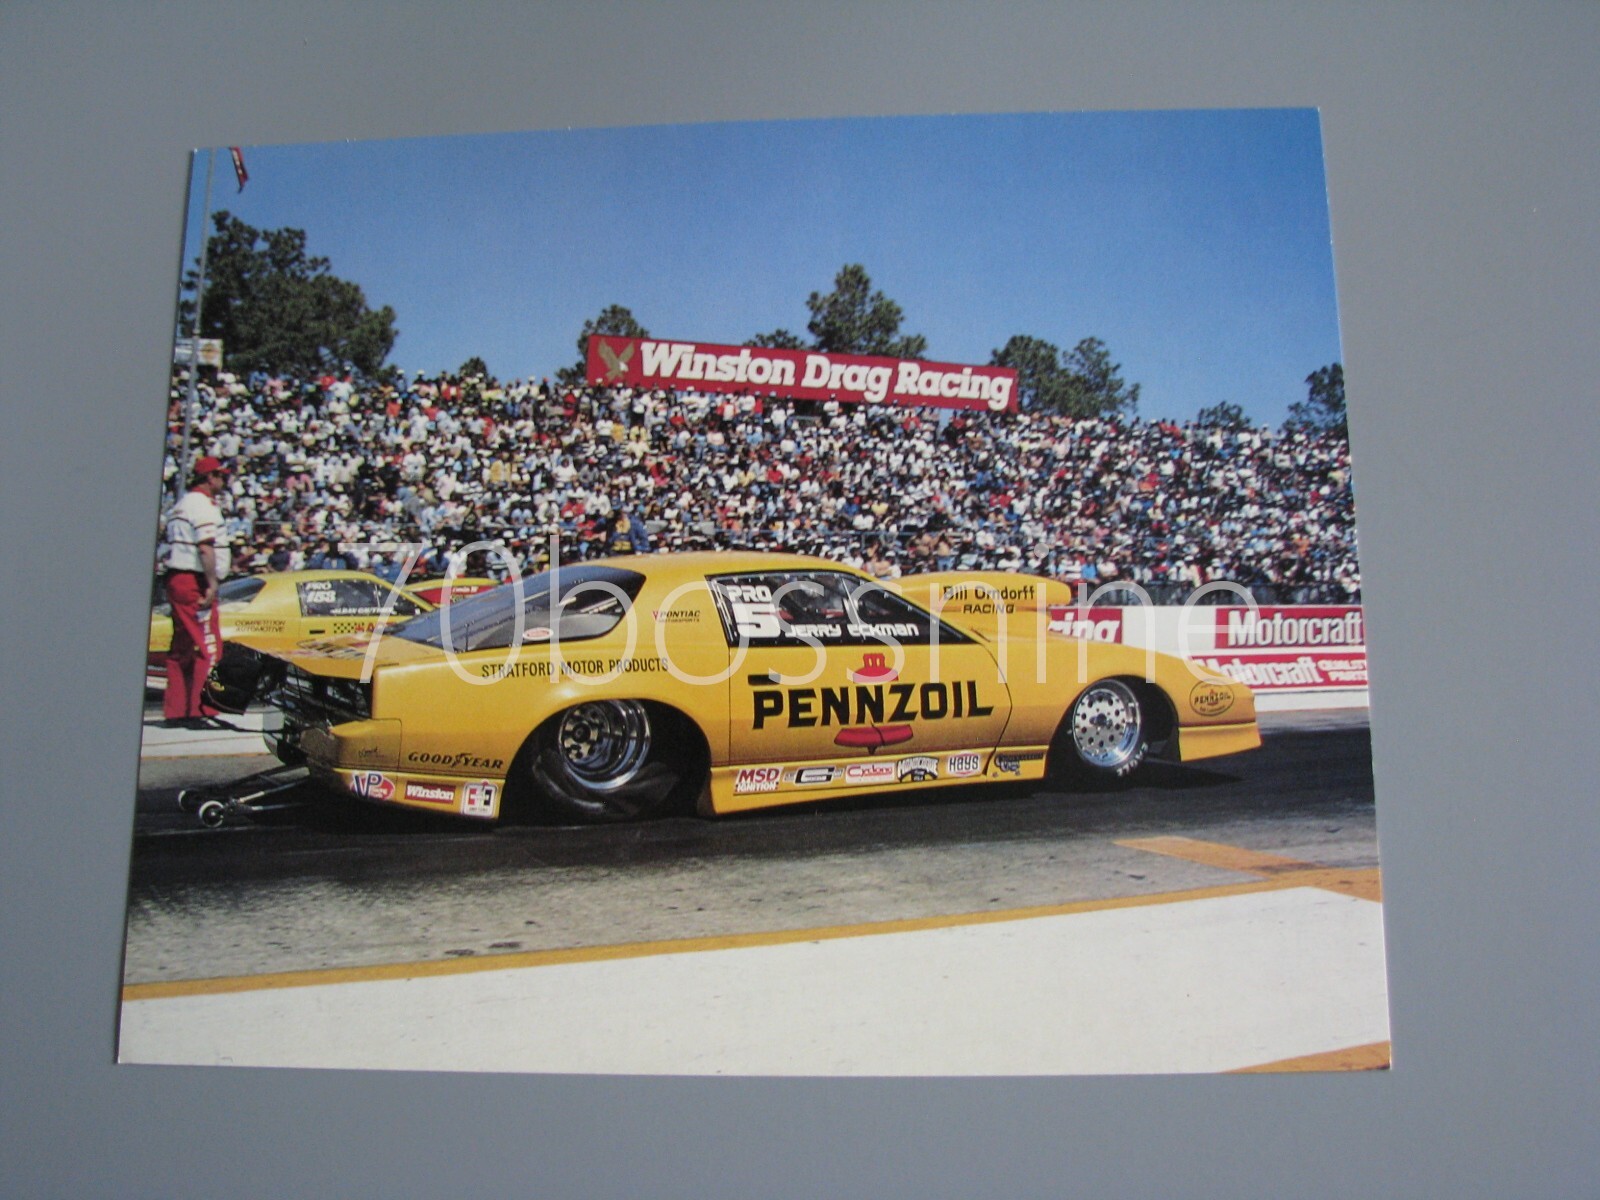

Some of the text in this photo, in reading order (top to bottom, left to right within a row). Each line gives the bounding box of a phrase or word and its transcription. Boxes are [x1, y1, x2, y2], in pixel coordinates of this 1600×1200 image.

[640, 341, 1013, 410] Winston Drag Racing
[727, 585, 773, 602] PRO
[943, 585, 968, 600] Bill
[660, 610, 700, 618] PONTIAC
[962, 603, 1015, 614] RACING
[731, 602, 781, 638] 5
[1227, 609, 1363, 647] Motorcraft
[481, 657, 669, 680] STRATFORD MOTOR PRODUCTS
[752, 680, 995, 730] PENNZOIL
[408, 752, 504, 769] GOODYEAR
[739, 768, 780, 783] MSD
[406, 785, 454, 801] Winston
